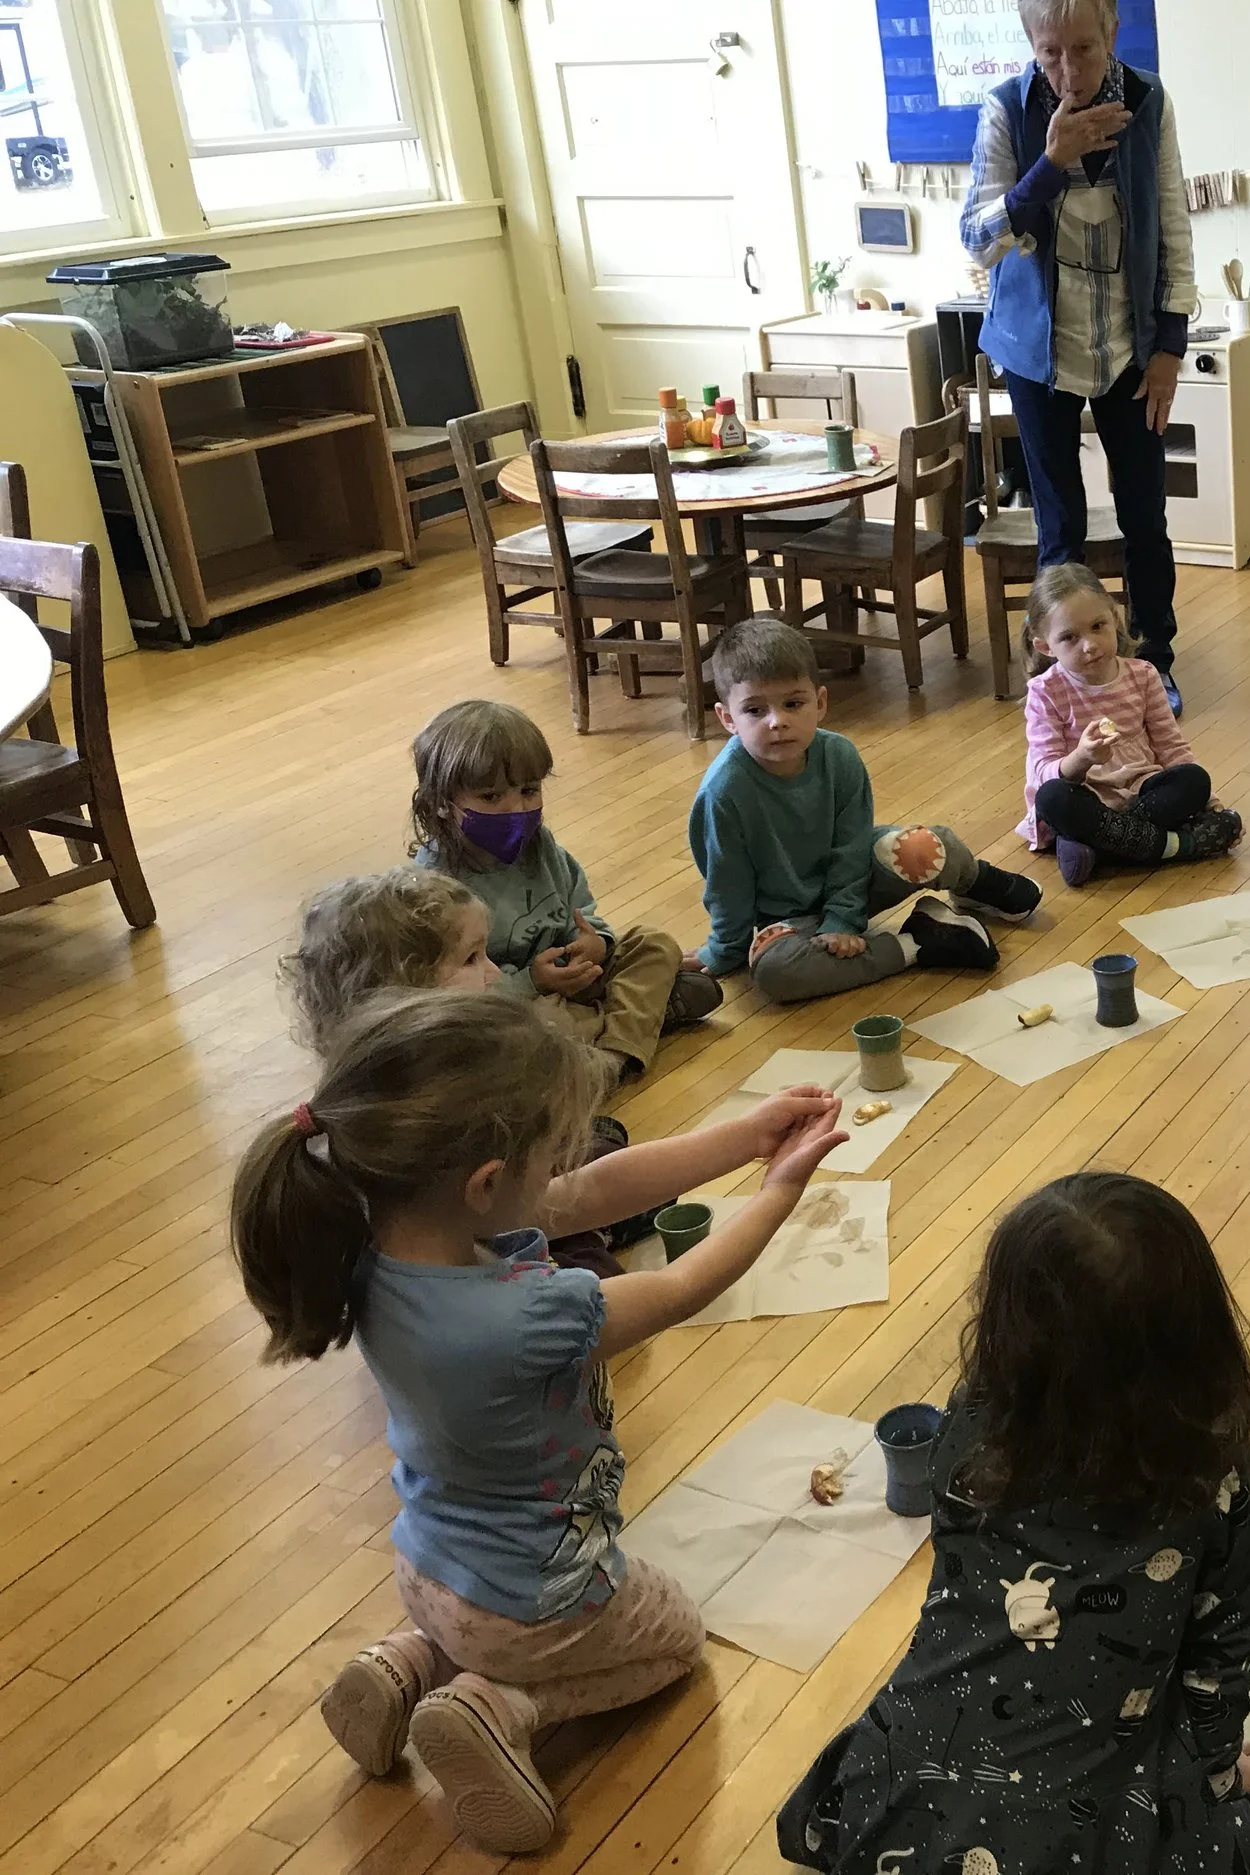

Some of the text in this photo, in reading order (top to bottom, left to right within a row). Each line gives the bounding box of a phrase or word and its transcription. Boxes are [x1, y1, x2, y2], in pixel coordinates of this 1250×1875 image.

[937, 51, 1021, 76] Aquí están mis
[1082, 1591, 1119, 1608] MEOW
[375, 1655, 404, 1687] crocs
